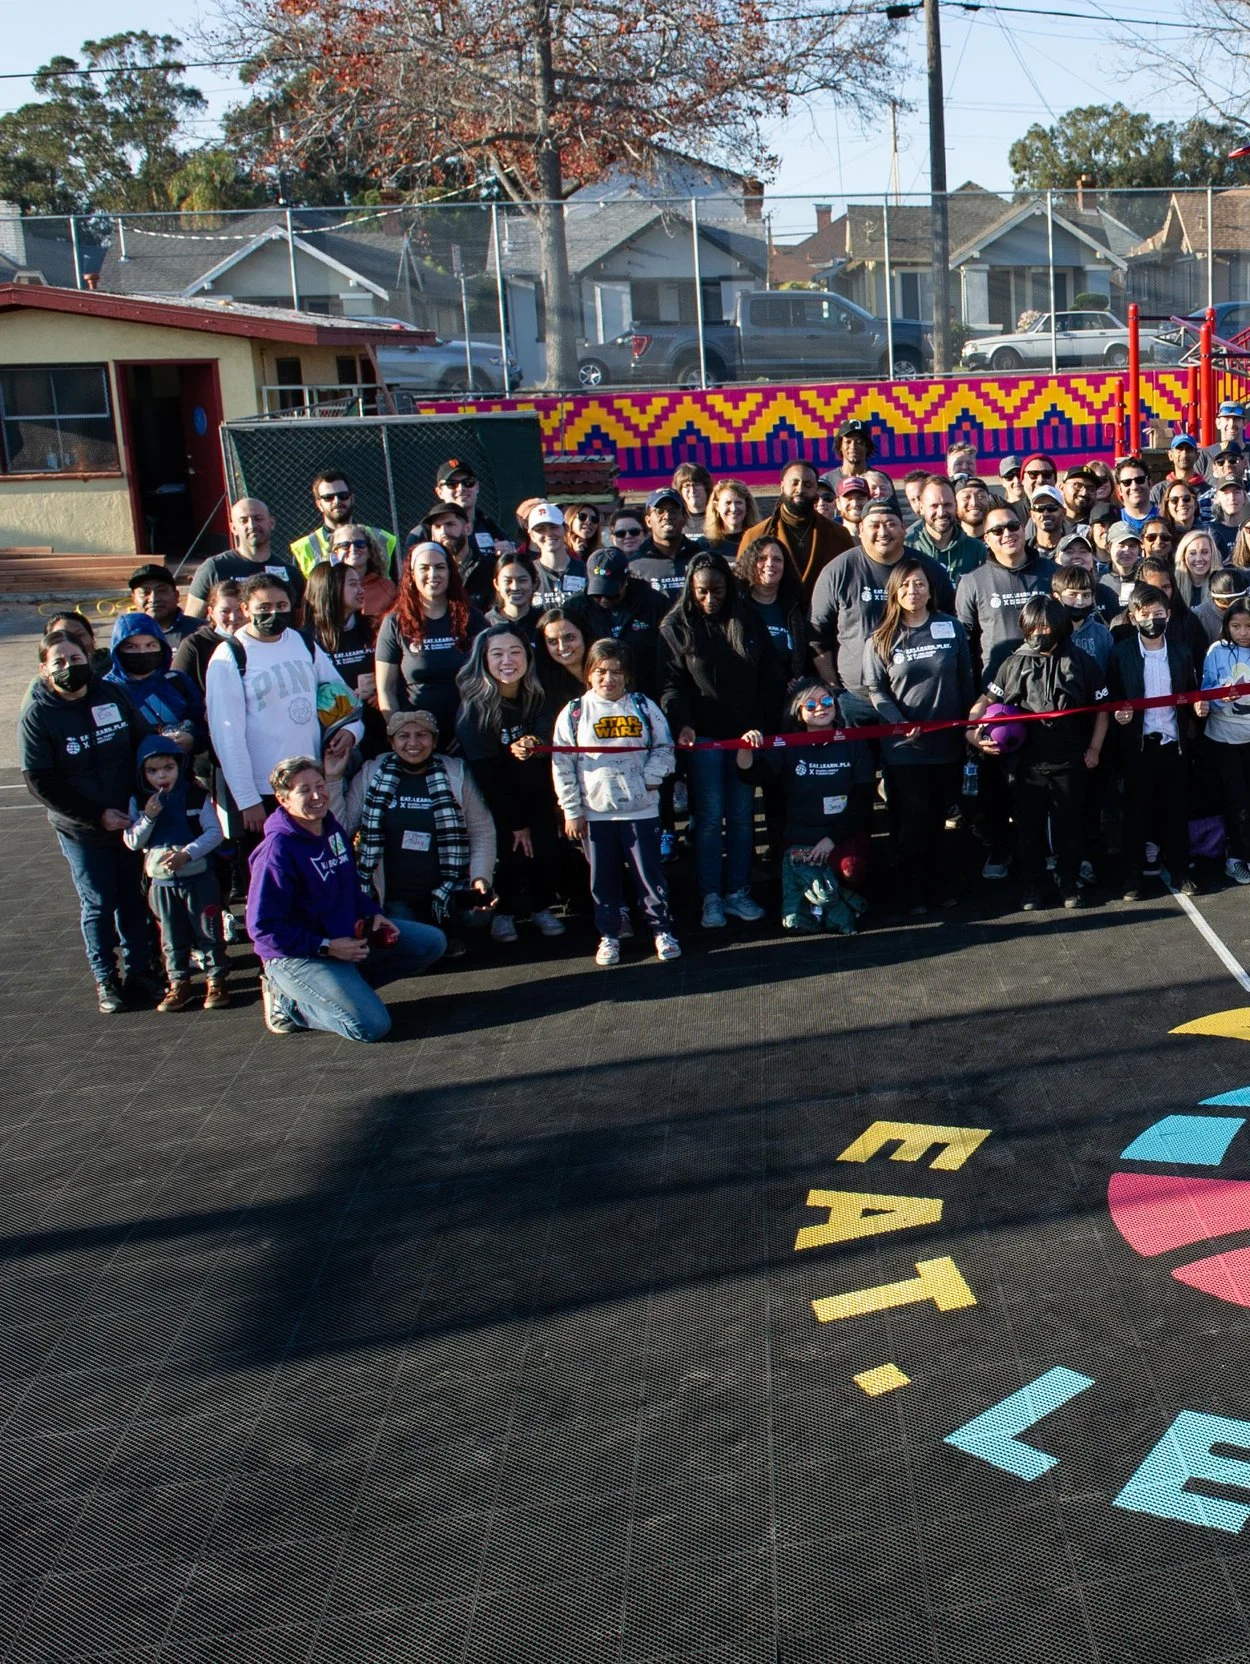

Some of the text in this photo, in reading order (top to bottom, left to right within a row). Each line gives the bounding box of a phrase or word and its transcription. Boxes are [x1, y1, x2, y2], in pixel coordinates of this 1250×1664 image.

[251, 660, 319, 712] PIN
[593, 715, 643, 728] STAR
[593, 726, 643, 738] WARS
[794, 1120, 993, 1398] EAT.
